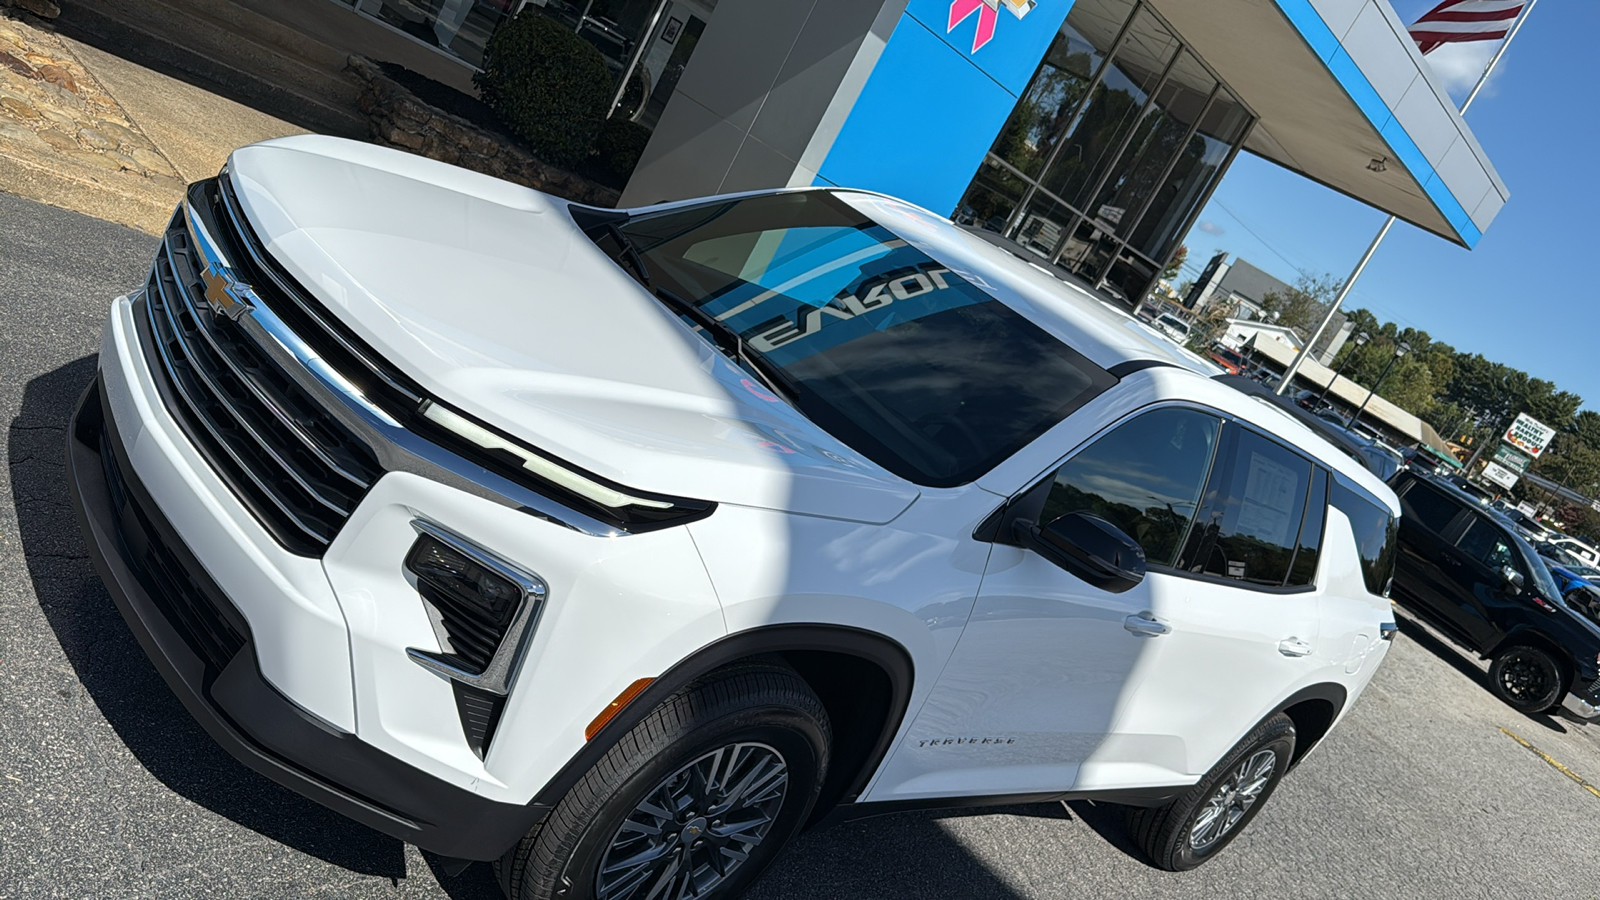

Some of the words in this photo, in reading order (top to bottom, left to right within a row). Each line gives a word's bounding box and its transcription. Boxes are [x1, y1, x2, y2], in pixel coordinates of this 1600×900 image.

[1515, 425, 1544, 444] HARVEST
[1516, 419, 1544, 437] HEALTHY
[919, 736, 1016, 748] TRAVERSE
